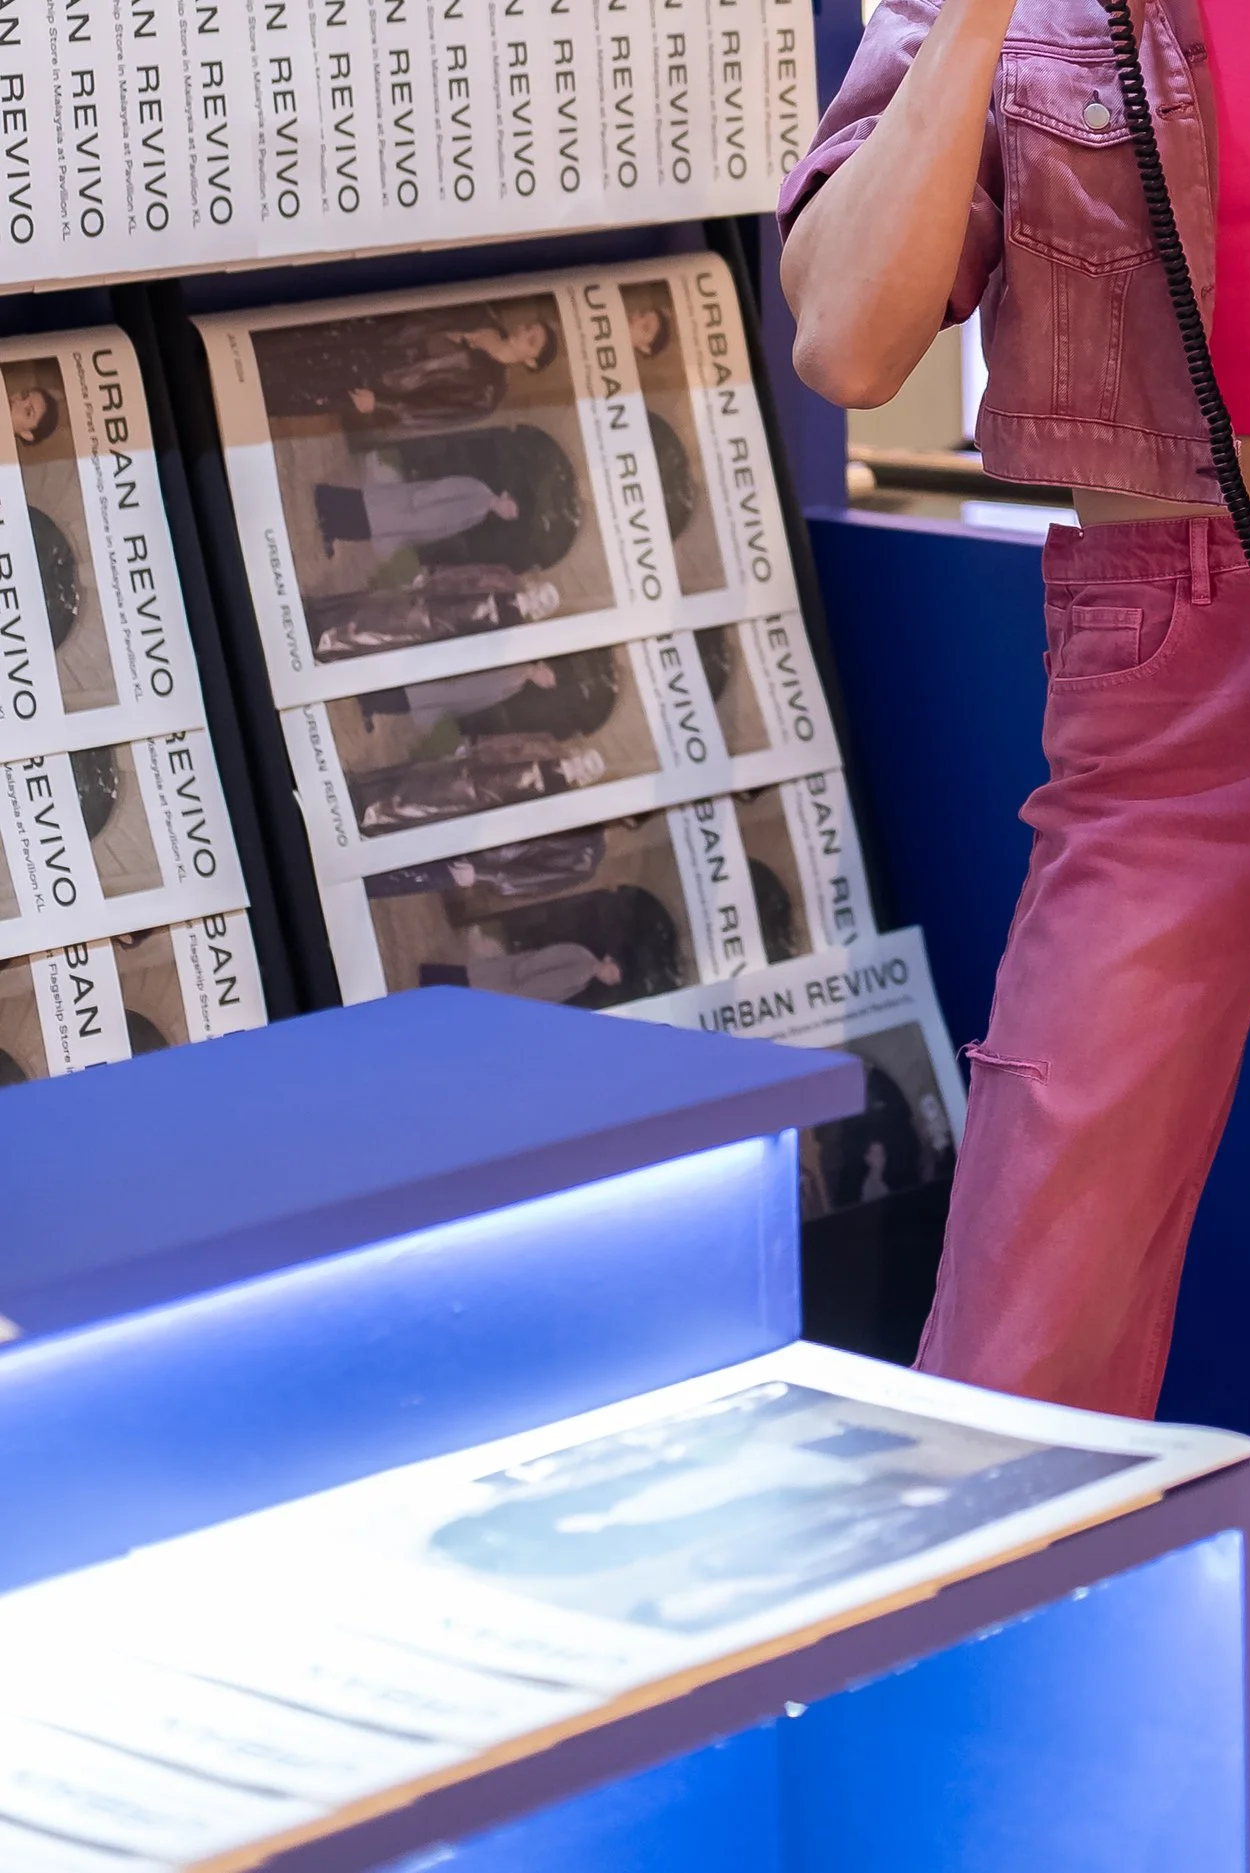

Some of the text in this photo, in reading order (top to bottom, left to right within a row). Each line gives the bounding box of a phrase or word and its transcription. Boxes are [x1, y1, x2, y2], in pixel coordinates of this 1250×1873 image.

[48, 26, 58, 66] Store
[52, 83, 63, 145] Malaysia
[507, 41, 535, 196] REVIVO
[553, 39, 580, 192] REVIVO
[610, 35, 637, 188] REVIVO
[666, 32, 691, 184] REVIVO
[721, 30, 746, 179] REVIVO
[1, 73, 34, 245] REVIVO
[57, 164, 68, 219] Pavilion
[71, 69, 104, 237] REVIVO
[136, 65, 169, 231] REVIVO
[200, 60, 232, 224] REVIVO
[269, 56, 299, 218] REVIVO
[328, 52, 359, 213] REVIVO
[388, 49, 418, 207] REVIVO
[446, 44, 474, 202] REVIVO
[583, 284, 628, 430] URBAN
[615, 452, 661, 601] REVIVO
[696, 271, 739, 416] URBAN
[728, 437, 771, 583] REVIVO
[92, 348, 174, 699] URBAN REVIVO
[264, 528, 302, 673] URBAN REVIVO
[693, 799, 730, 883] BAN
[805, 772, 842, 856] BAN
[63, 942, 102, 1038] BAN
[203, 913, 240, 1007] BAN
[698, 989, 796, 1034] URBAN
[805, 958, 909, 1010] REVIVO
